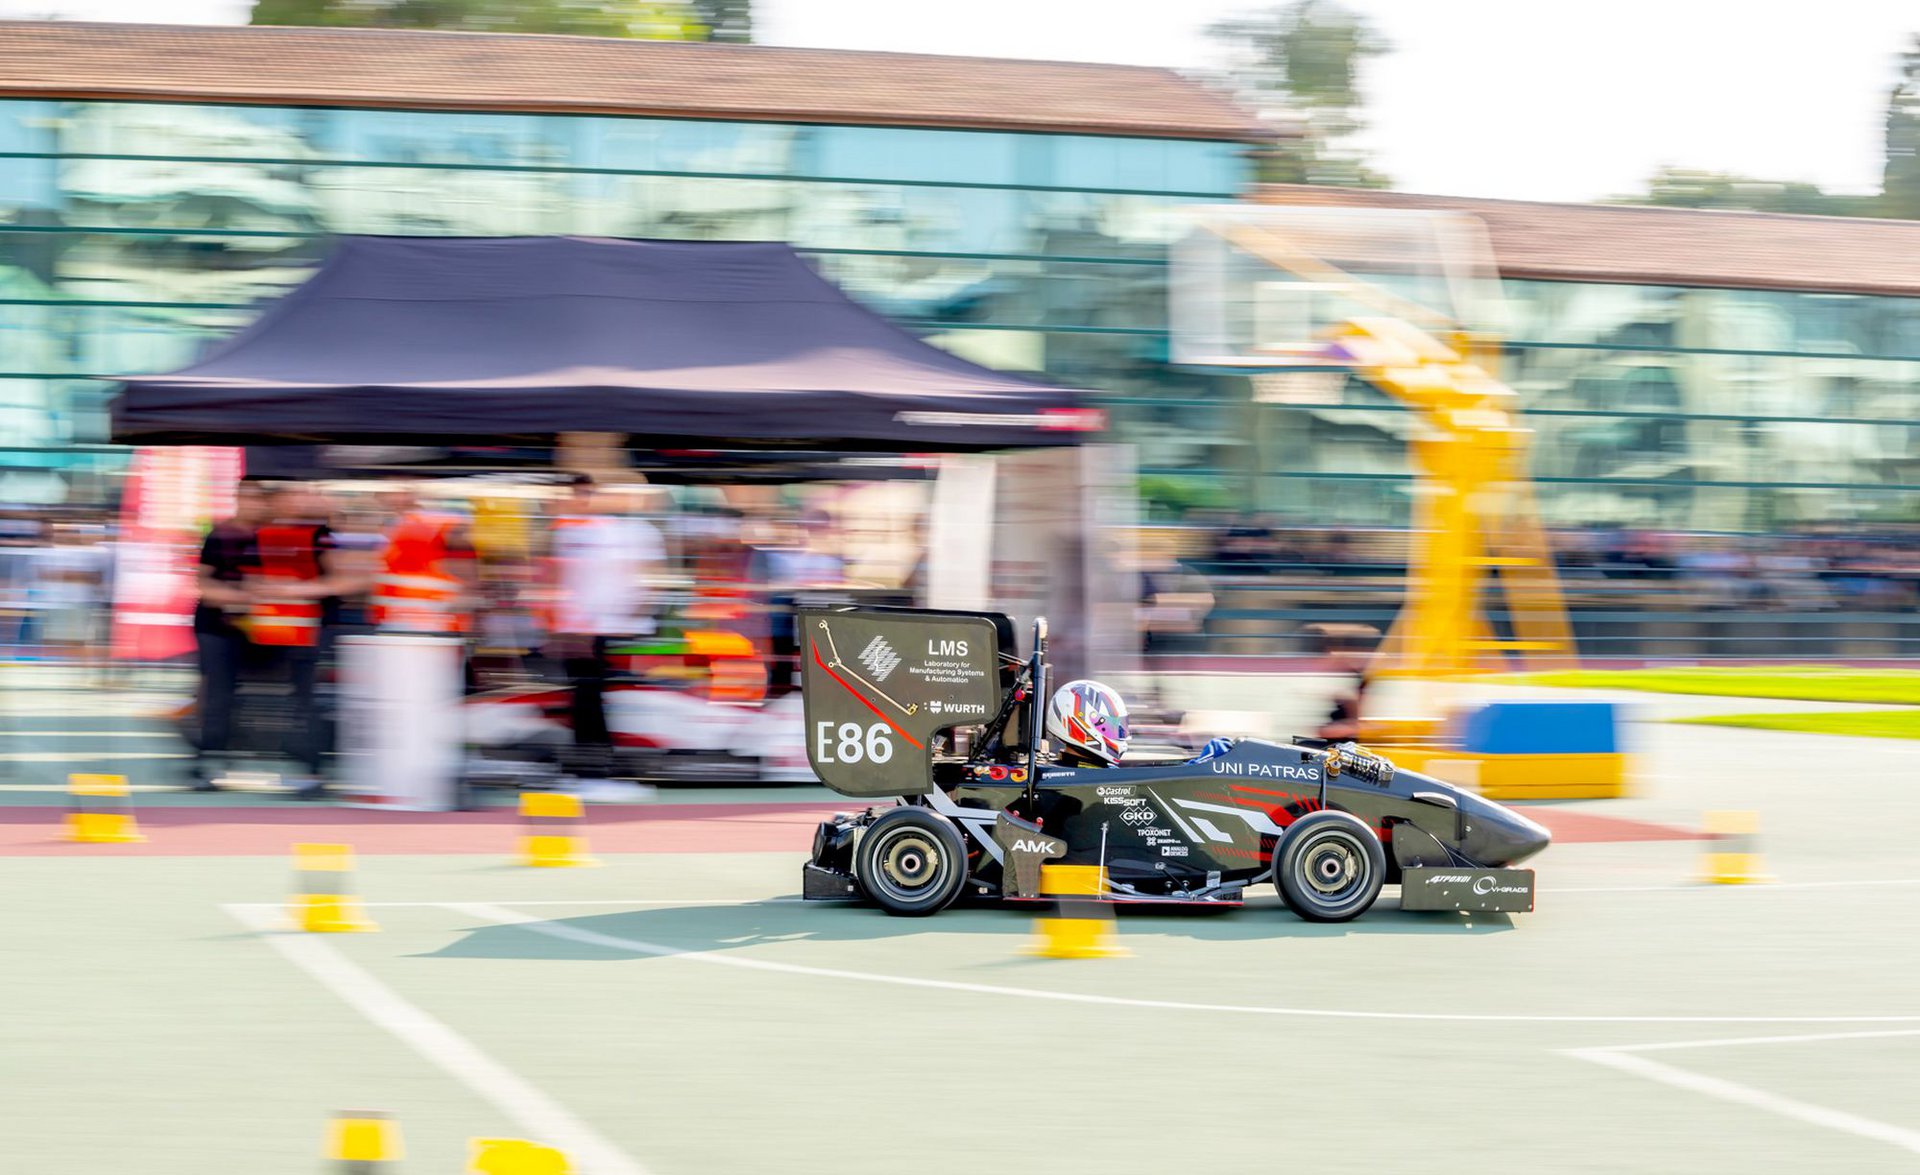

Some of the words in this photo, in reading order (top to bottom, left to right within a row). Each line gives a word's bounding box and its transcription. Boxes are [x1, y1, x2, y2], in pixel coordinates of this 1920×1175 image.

[928, 639, 968, 656] LMS
[924, 660, 959, 669] Laboratory
[909, 667, 956, 676] Manufacturing
[957, 668, 985, 677] Systems
[931, 675, 969, 683] Automation
[817, 721, 893, 764] E86
[1212, 761, 1242, 775] UNI
[1248, 763, 1319, 780] PATRAS
[1105, 787, 1131, 795] Castrol
[1123, 811, 1154, 820] GKD
[1012, 840, 1055, 854] AMK
